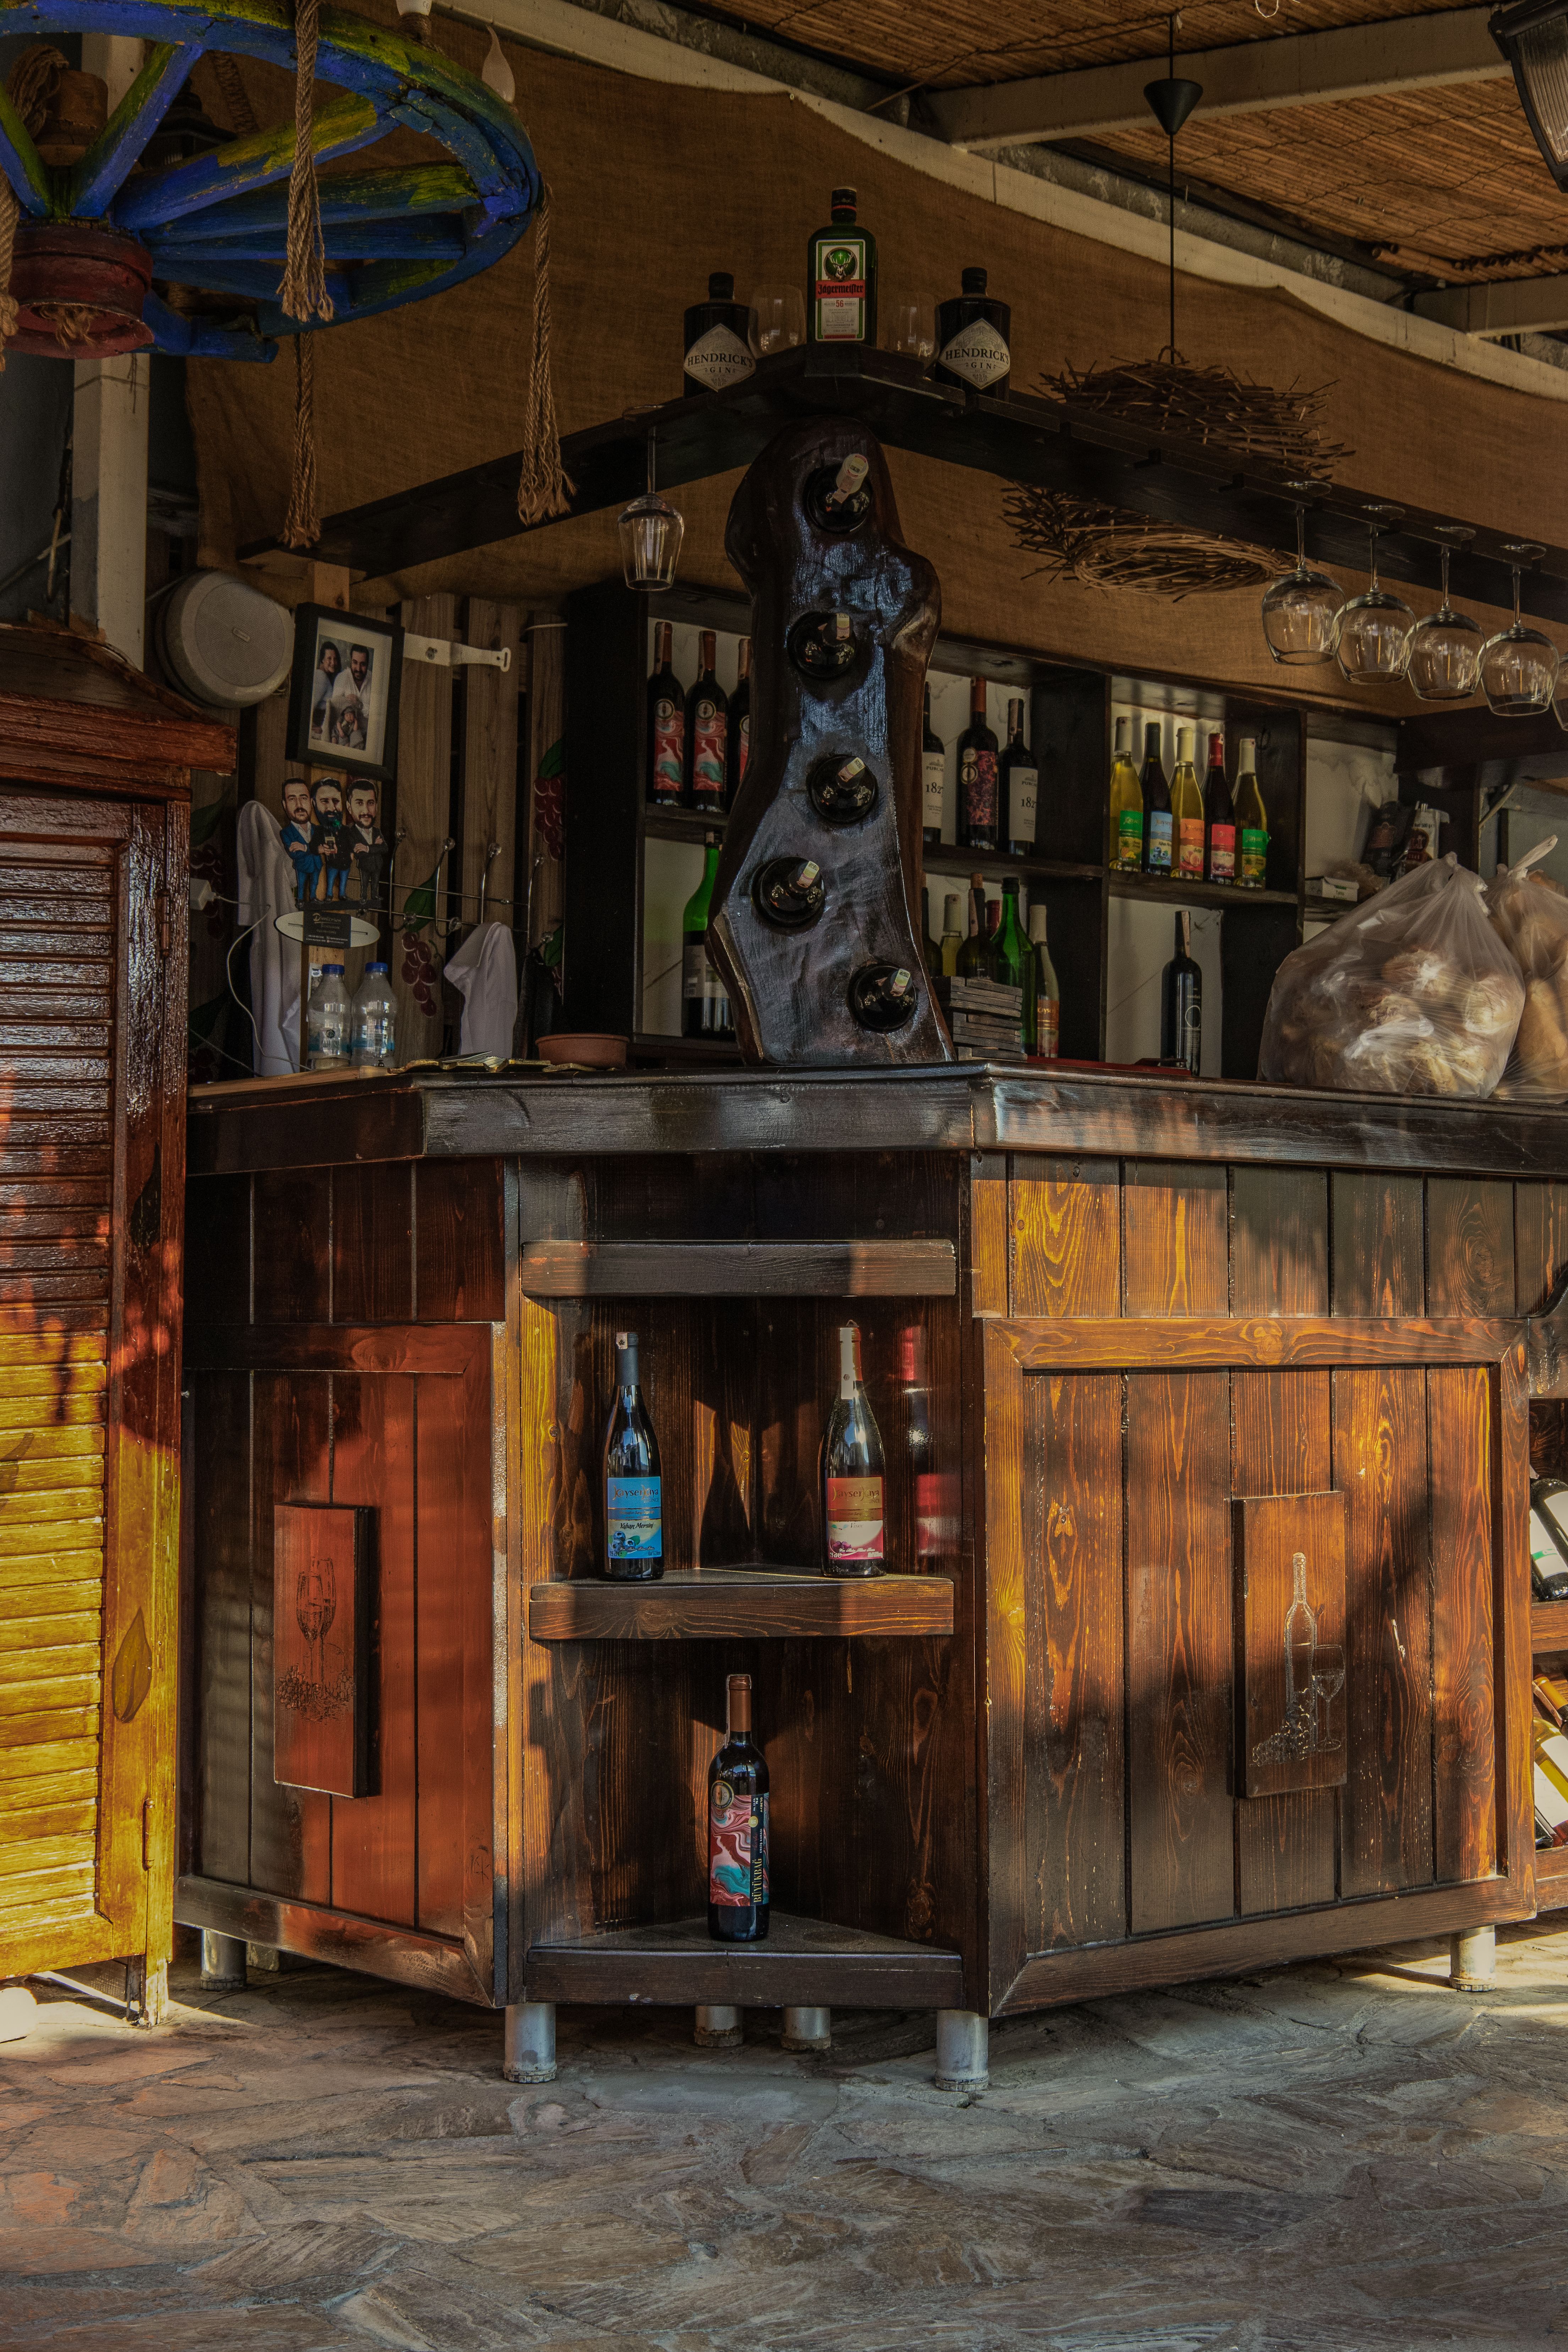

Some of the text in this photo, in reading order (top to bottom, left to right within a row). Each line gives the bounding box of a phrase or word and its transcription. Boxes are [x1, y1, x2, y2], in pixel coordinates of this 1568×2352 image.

[687, 353, 752, 368] HENDRICK'S
[945, 348, 1009, 364] HENDRICK'S
[752, 1858, 762, 1903] BÜYÜKBAĞ
